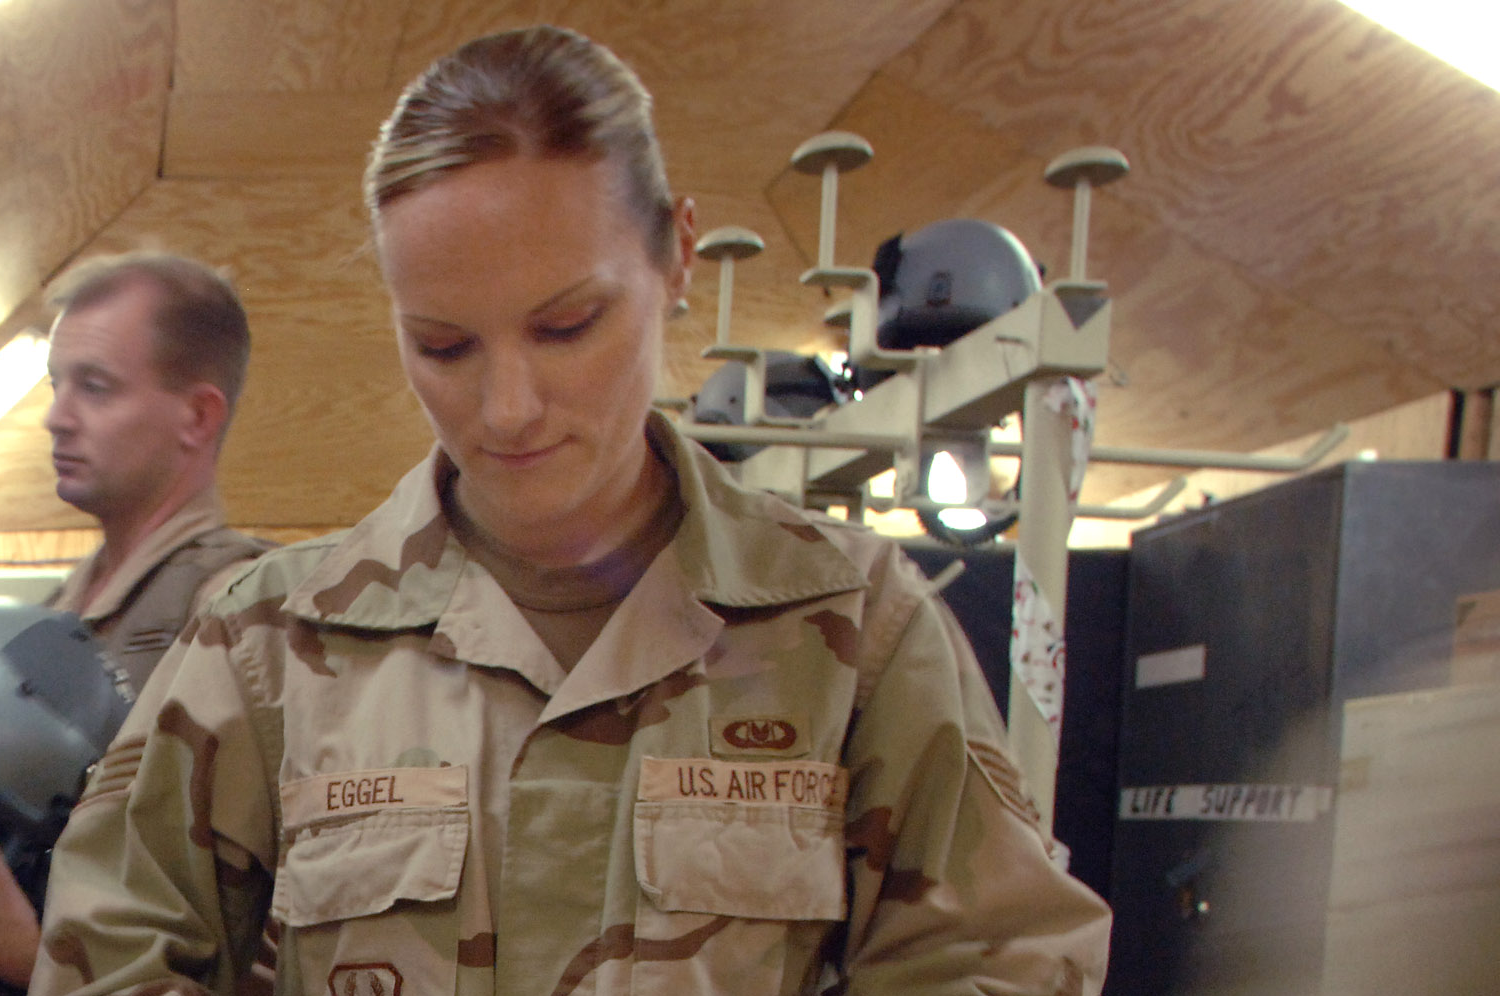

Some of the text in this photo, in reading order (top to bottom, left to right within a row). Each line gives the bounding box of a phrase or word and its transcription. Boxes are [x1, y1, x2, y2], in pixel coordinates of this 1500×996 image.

[327, 775, 404, 811] EGGEL
[678, 766, 718, 797] U.S.
[727, 770, 766, 800] AIR
